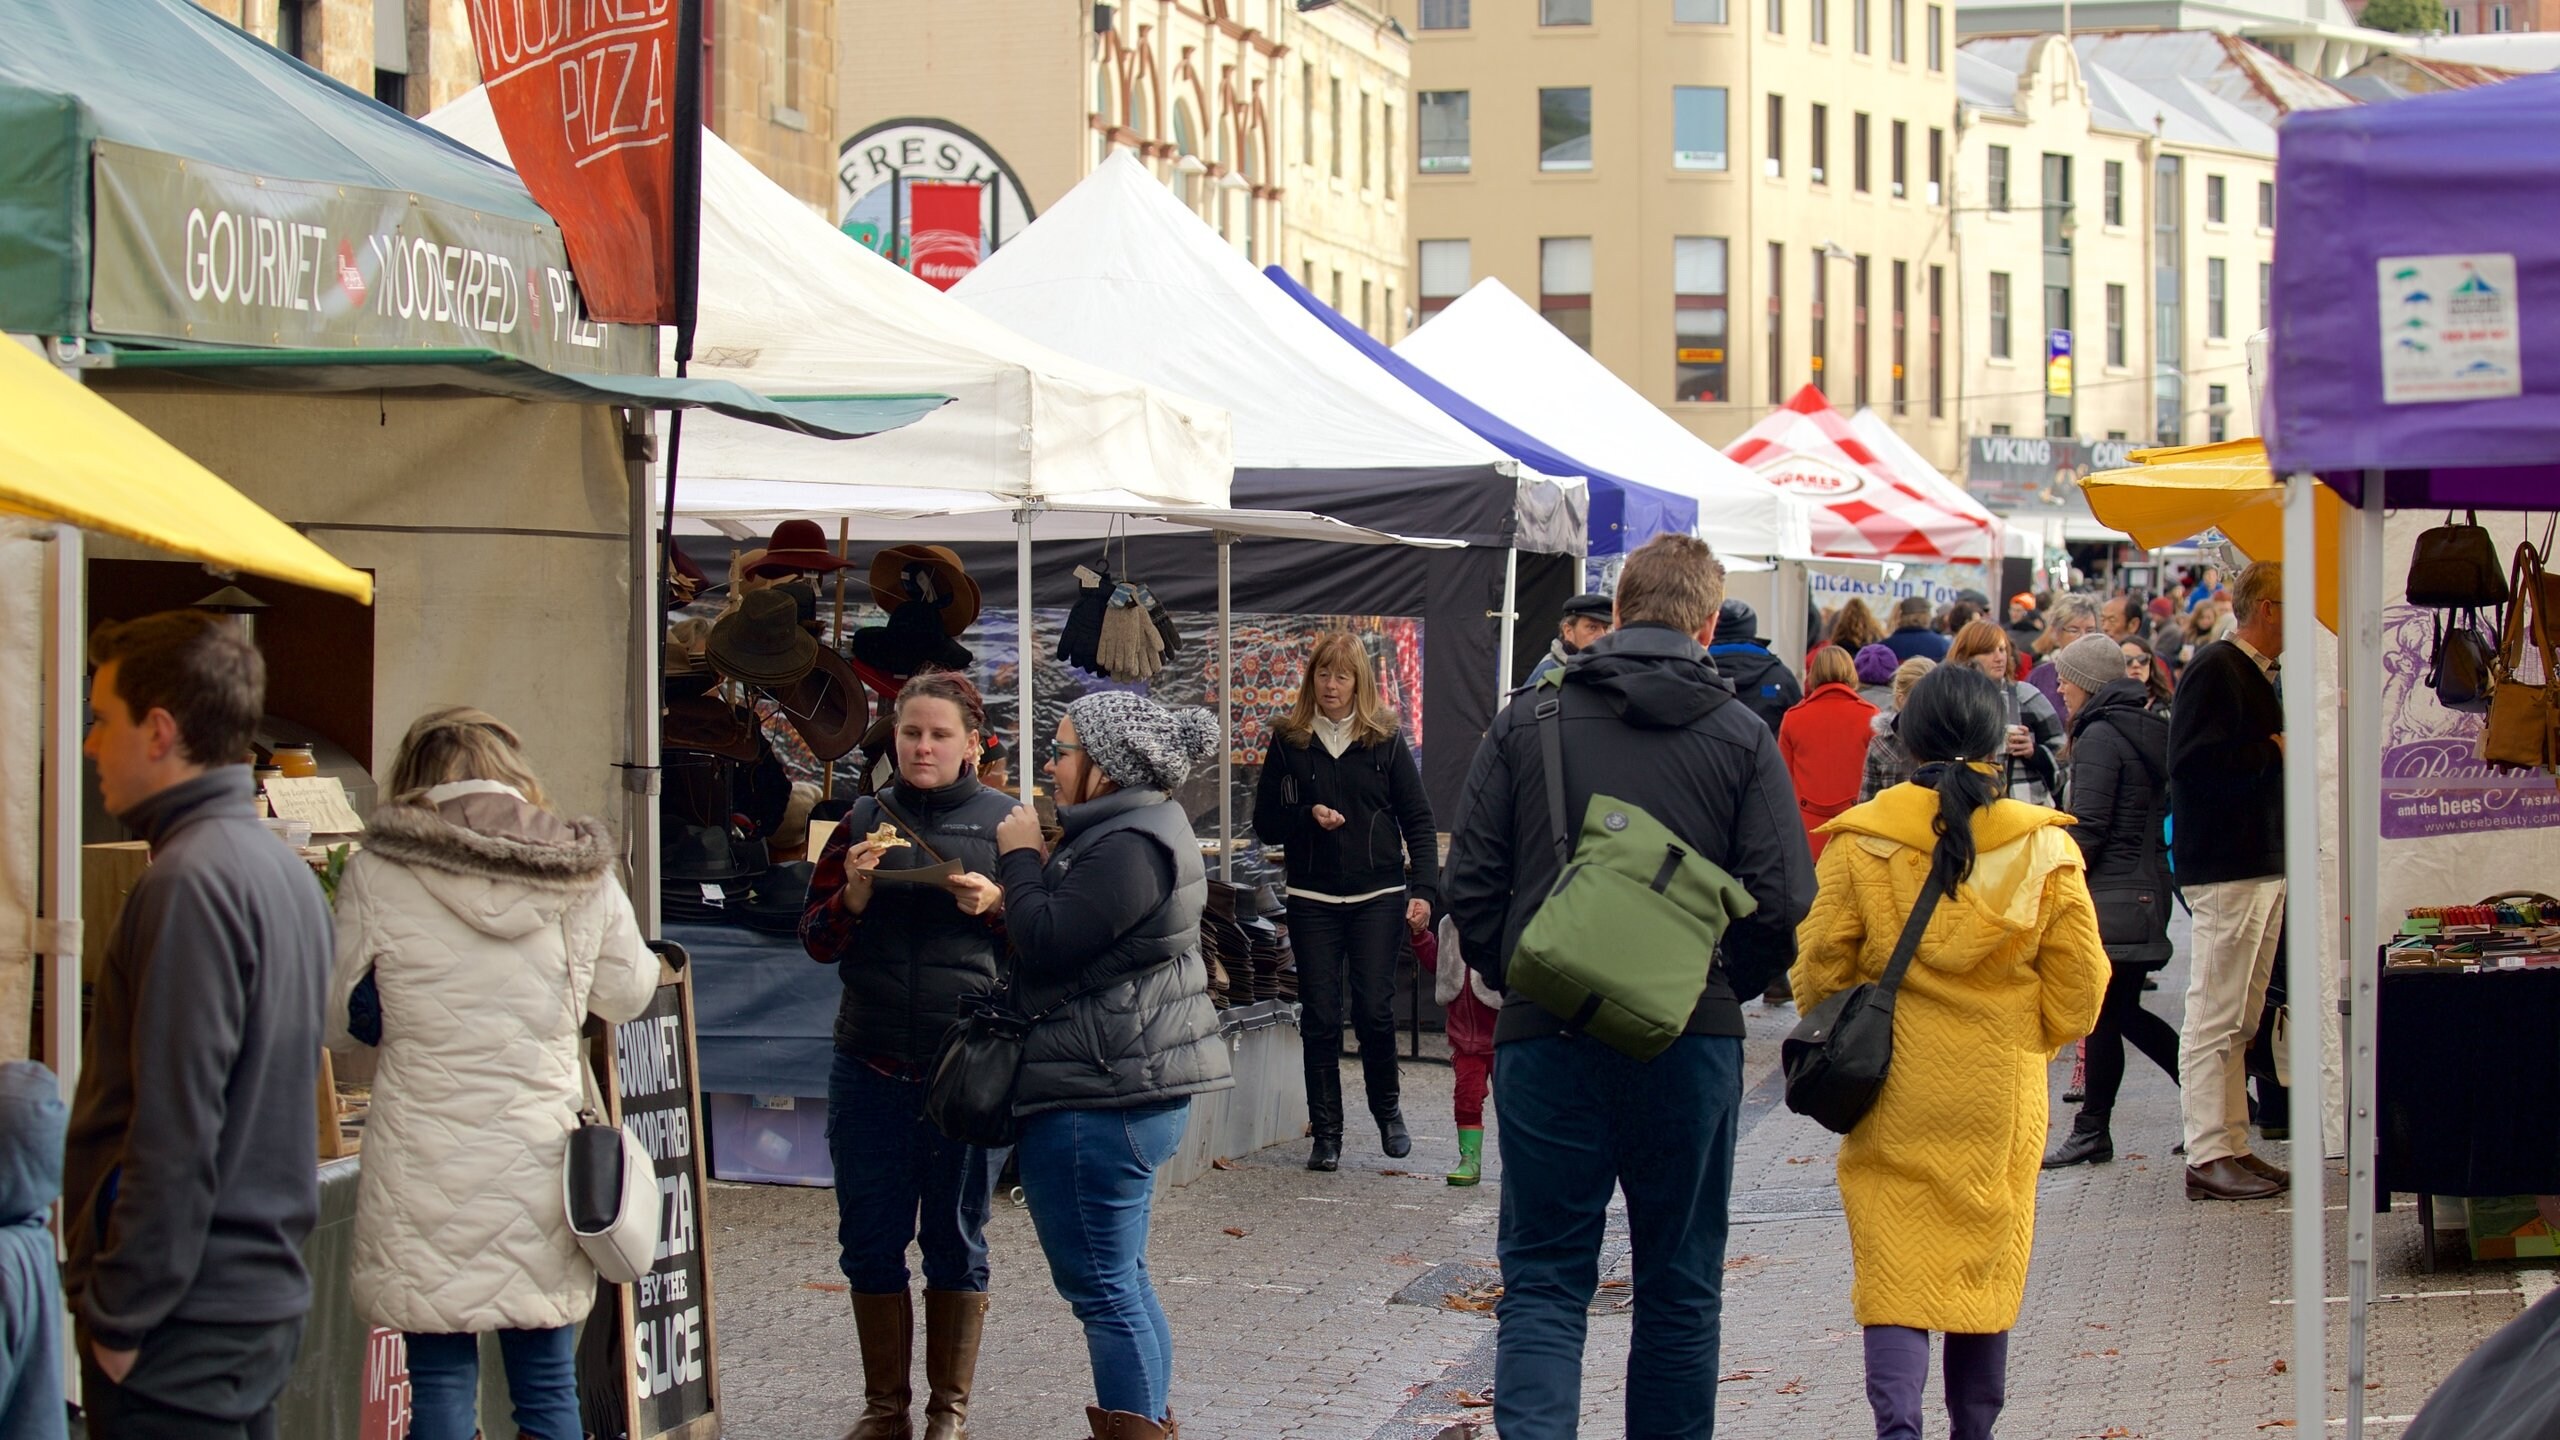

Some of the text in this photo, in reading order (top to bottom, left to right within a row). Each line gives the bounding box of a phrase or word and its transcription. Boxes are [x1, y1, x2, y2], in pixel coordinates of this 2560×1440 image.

[559, 38, 667, 152] PIZZA
[839, 138, 995, 195] FRESH
[186, 207, 327, 312] GOURMET
[368, 234, 519, 334] WOODFIRED
[1981, 437, 2051, 465] VIKING
[1893, 580, 1913, 598] in
[2398, 796, 2482, 817] and the bees
[615, 1014, 682, 1098] GOURMET
[623, 1106, 690, 1161] OODFIRED
[639, 1268, 688, 1308] BY THE
[634, 1305, 702, 1400] SLICE
